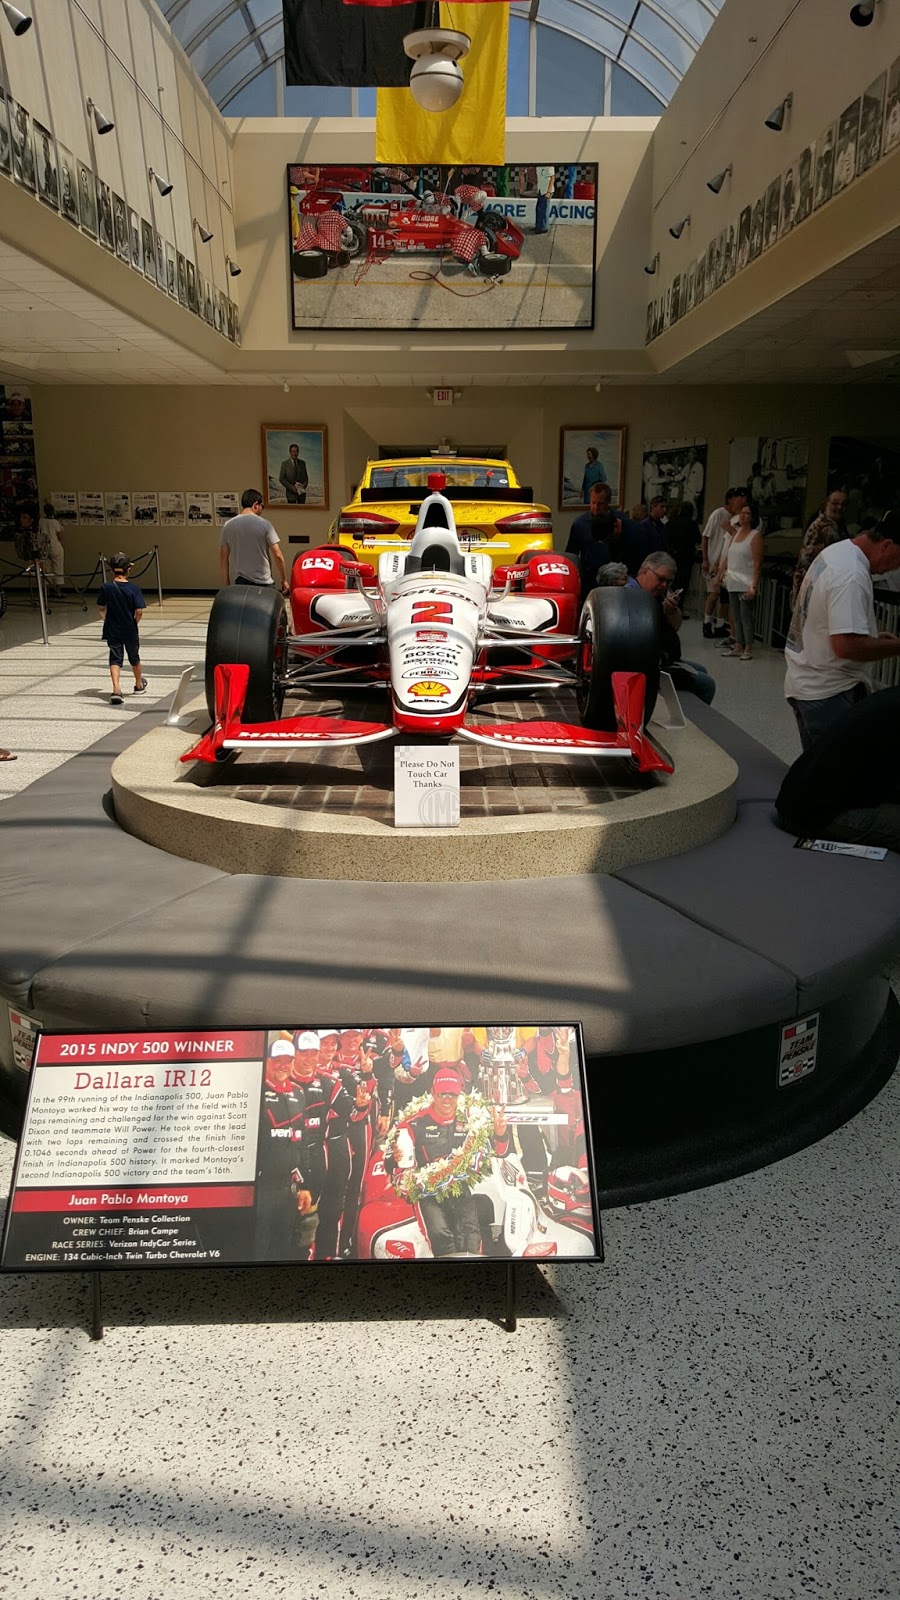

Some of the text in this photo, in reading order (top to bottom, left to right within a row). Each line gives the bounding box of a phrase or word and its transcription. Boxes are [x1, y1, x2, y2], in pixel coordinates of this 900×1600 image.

[411, 214, 439, 222] GILMORE
[548, 205, 595, 219] ACING
[372, 234, 386, 248] 14
[438, 390, 449, 400] EXIT
[302, 558, 334, 570] PPG
[538, 563, 570, 575] PPG
[391, 588, 478, 606] verizon
[411, 601, 454, 625] 2
[405, 650, 456, 660] BOSCH
[790, 1033, 814, 1050] TEAM
[60, 1040, 234, 1056] 2015 INDY 500 WINNER
[781, 1042, 816, 1063] PENSKE
[74, 1070, 211, 1089] Dallara IR12
[78, 1096, 107, 1104] running
[135, 1093, 183, 1102] Indianapolis
[32, 1107, 65, 1115] Montoya
[29, 1118, 46, 1126] laps
[48, 1117, 88, 1125] remaining
[108, 1115, 151, 1123] challenged
[196, 1113, 225, 1122] against
[67, 1138, 83, 1146] laps
[58, 1160, 106, 1168] Indianapolis
[129, 1158, 157, 1166] history.
[203, 1156, 244, 1164] Montoya's
[52, 1170, 101, 1179] Indianapolis
[123, 1169, 150, 1177] victory
[68, 1193, 188, 1205] Juan Pablo Montoya
[151, 1227, 178, 1235] Campe
[140, 1240, 171, 1248] IndyCar
